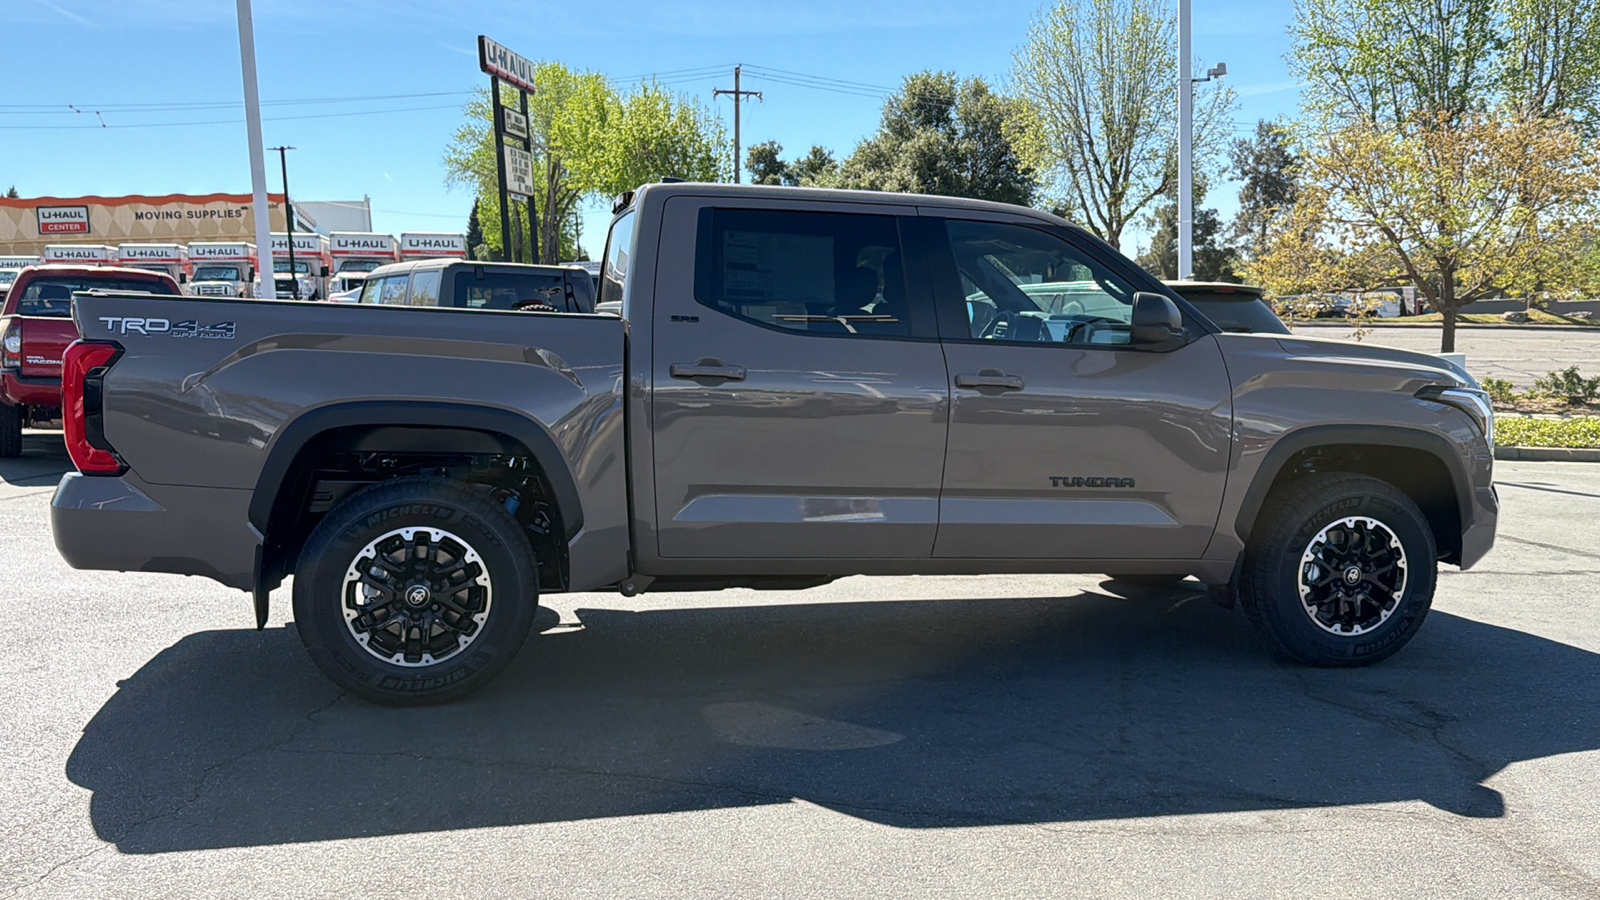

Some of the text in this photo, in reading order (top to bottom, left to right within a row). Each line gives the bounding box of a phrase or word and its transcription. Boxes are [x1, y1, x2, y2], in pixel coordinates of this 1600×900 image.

[135, 210, 242, 220] MOVING SUPPLIES
[337, 239, 387, 248] U-HAUL
[409, 239, 458, 248] U-HAUL
[98, 316, 171, 336] TRD
[1049, 476, 1136, 488] TUNDRA
[367, 504, 450, 525] MICHELIN
[1302, 498, 1361, 535] MICHELIN
